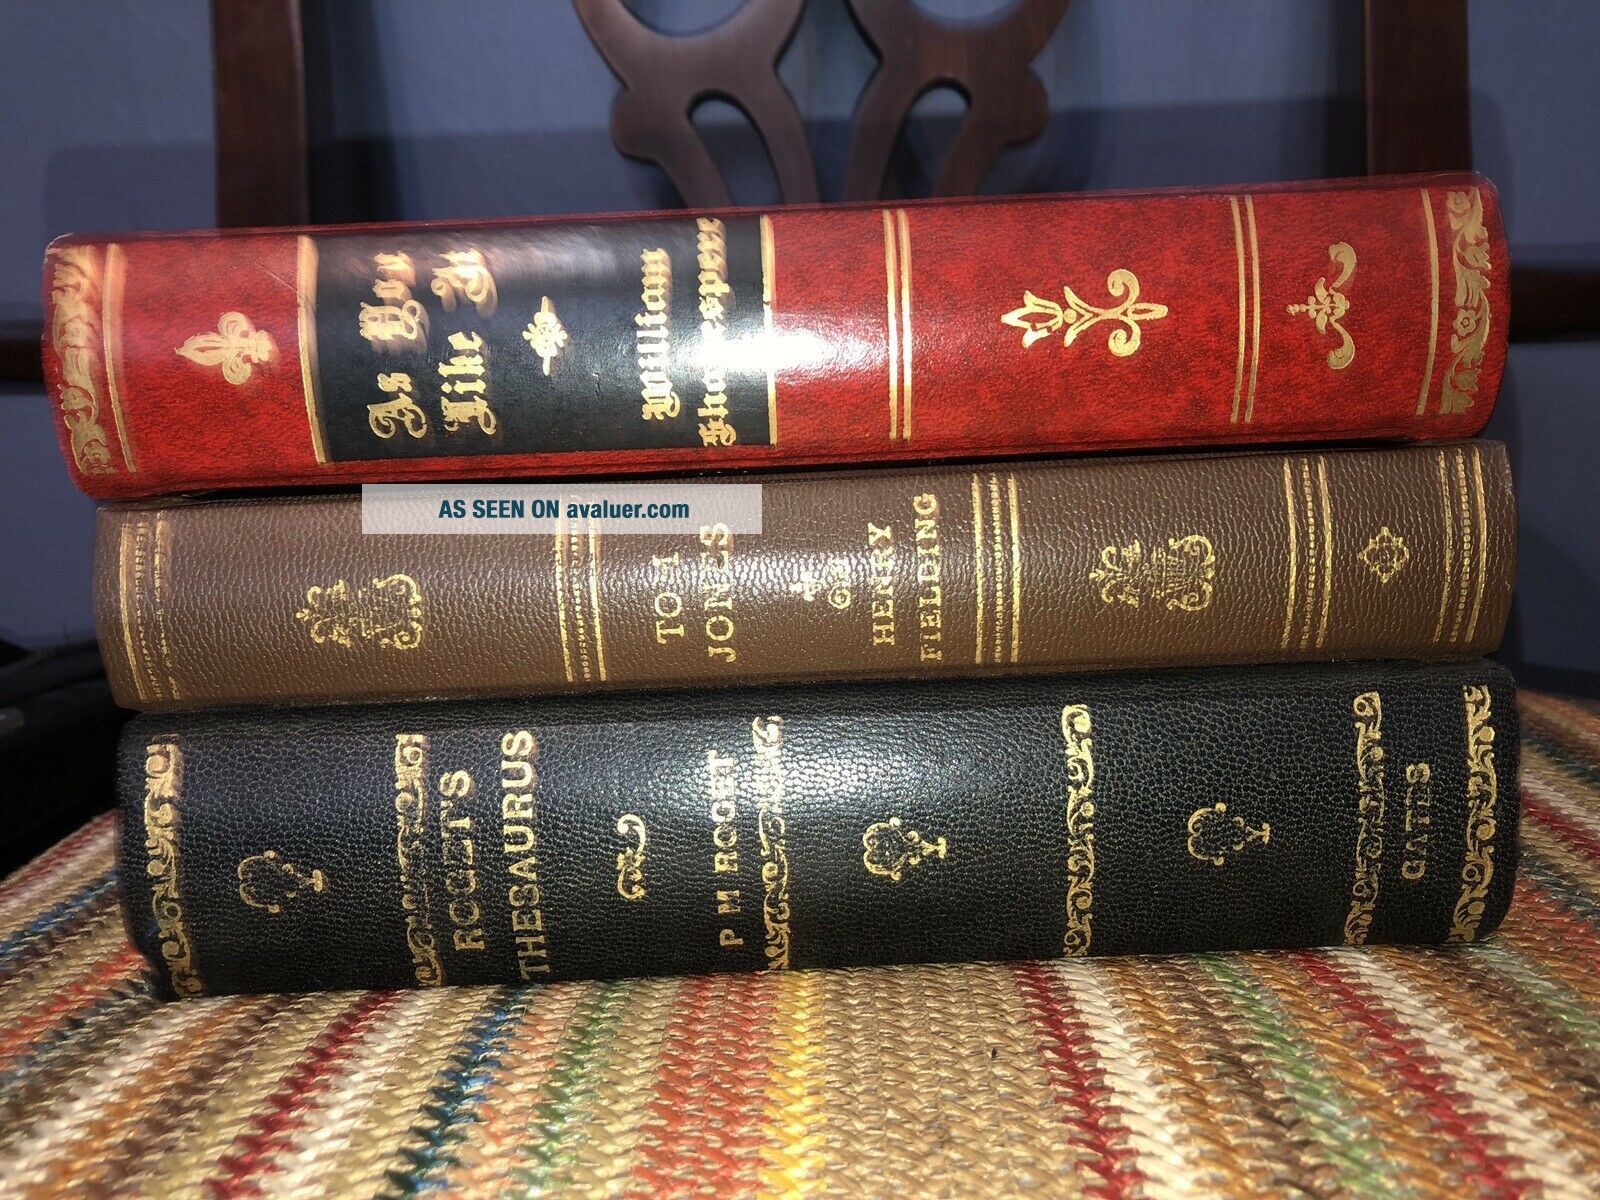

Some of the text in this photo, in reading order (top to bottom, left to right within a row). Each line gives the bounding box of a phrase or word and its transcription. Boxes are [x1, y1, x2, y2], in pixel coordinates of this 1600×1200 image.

[358, 251, 427, 439] As You
[438, 331, 497, 435] Like
[636, 247, 678, 421] William
[695, 217, 736, 447] Shaespere
[699, 522, 736, 663] JONES
[867, 522, 895, 646] HENRY
[912, 493, 942, 662] FIELDING
[440, 769, 485, 951] ROGET'S
[501, 730, 550, 980] THESAURUS
[708, 749, 743, 947] P M ROGET
[1402, 762, 1431, 880] GATES
